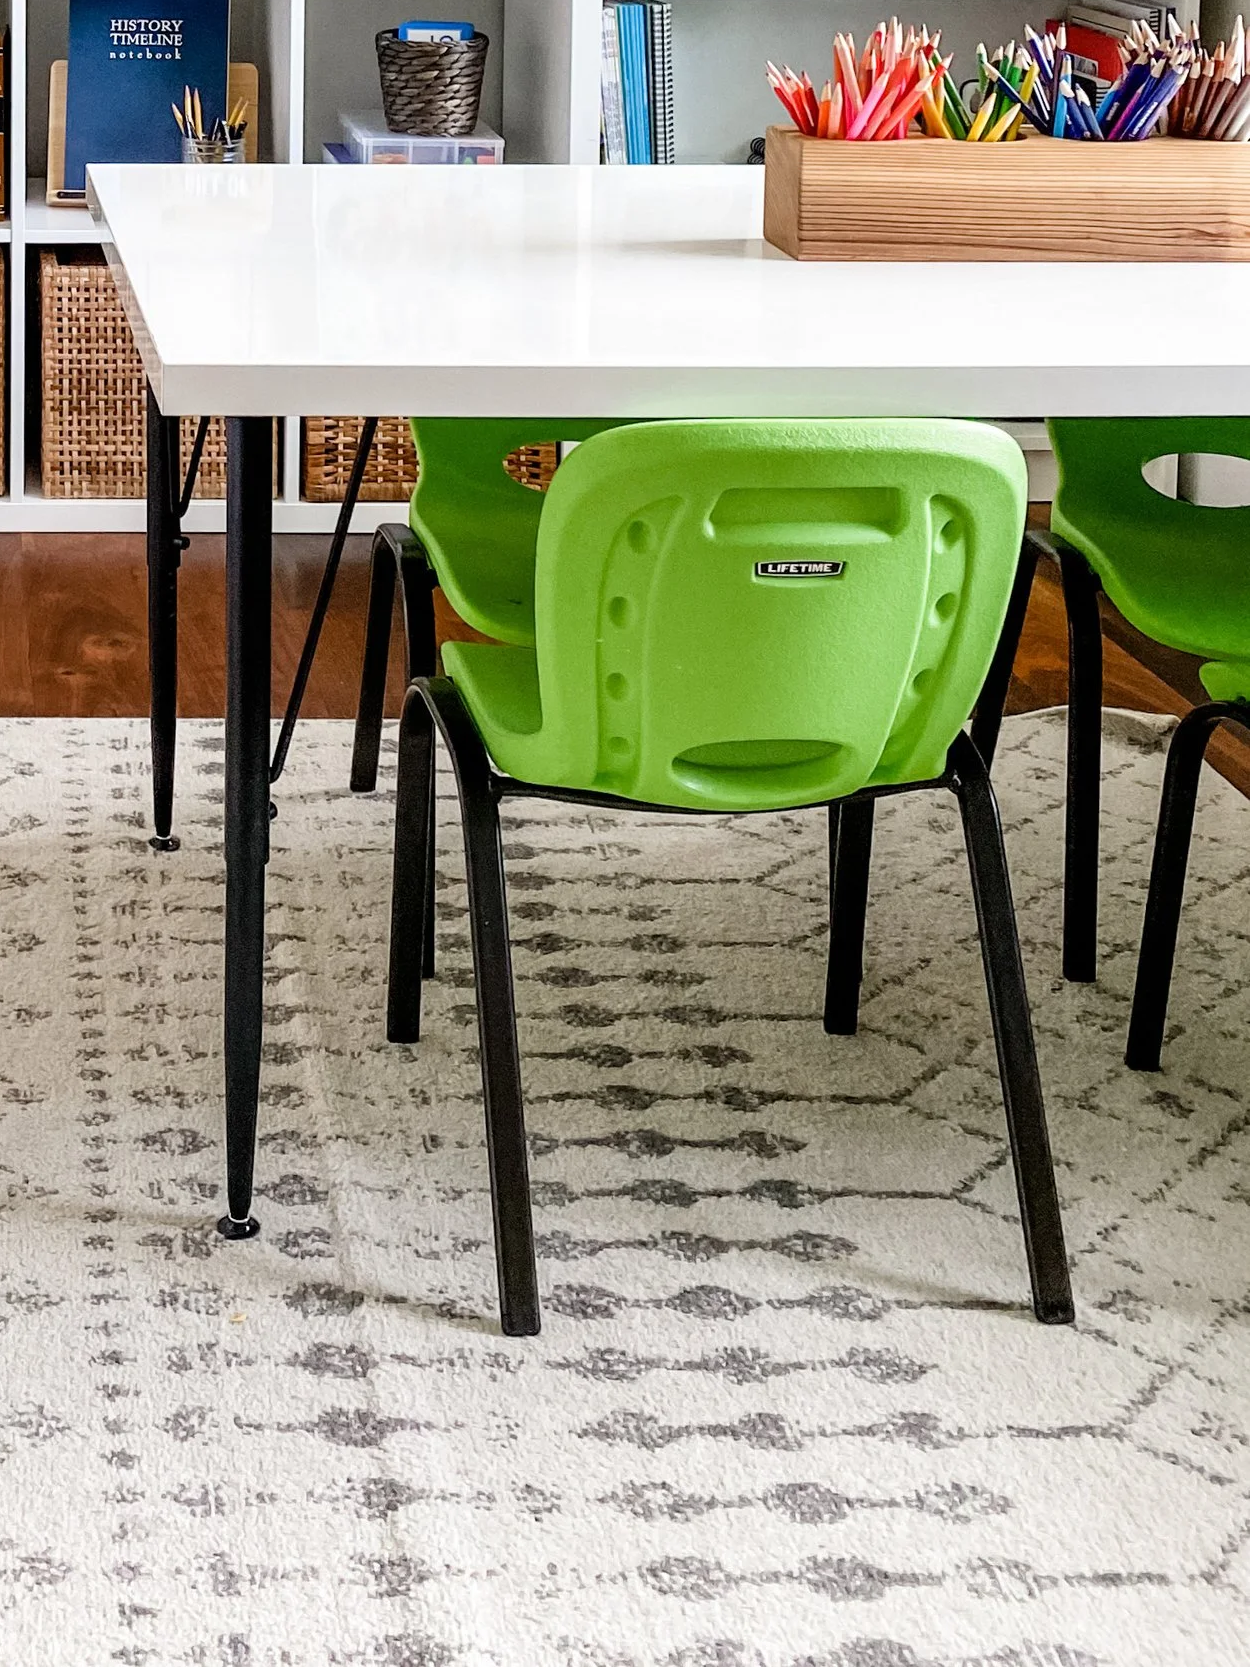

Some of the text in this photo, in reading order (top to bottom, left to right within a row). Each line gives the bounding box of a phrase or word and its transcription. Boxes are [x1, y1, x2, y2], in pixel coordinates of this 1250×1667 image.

[110, 19, 184, 33] HISTORY
[109, 33, 184, 47] TIMELINE
[109, 48, 182, 60] notebook
[767, 563, 833, 573] LIFETIME
